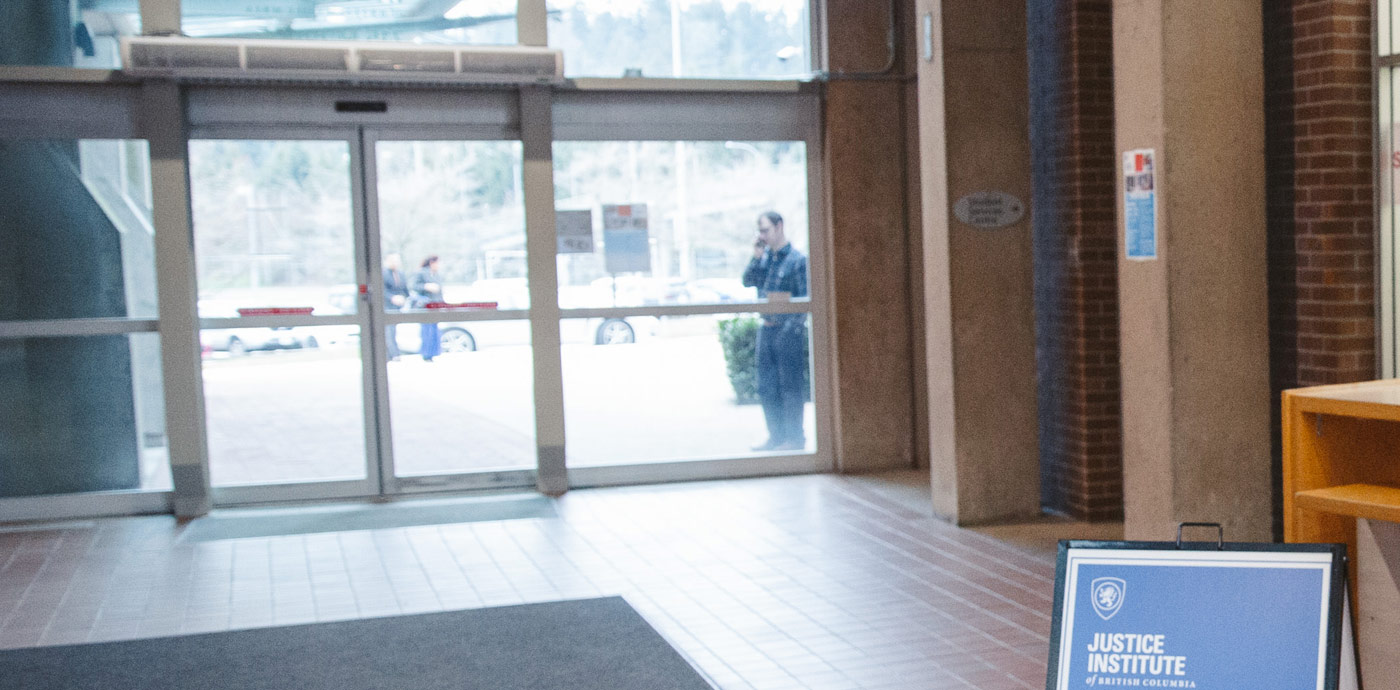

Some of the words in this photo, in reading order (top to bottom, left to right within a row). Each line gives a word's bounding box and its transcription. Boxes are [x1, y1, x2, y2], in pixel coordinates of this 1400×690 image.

[1087, 632, 1165, 654] JUSTICE
[1087, 653, 1187, 676] INSTITUTE
[1085, 674, 1098, 687] of
[1098, 677, 1140, 686] BRITISH
[1142, 678, 1196, 688] COLUMBIA
